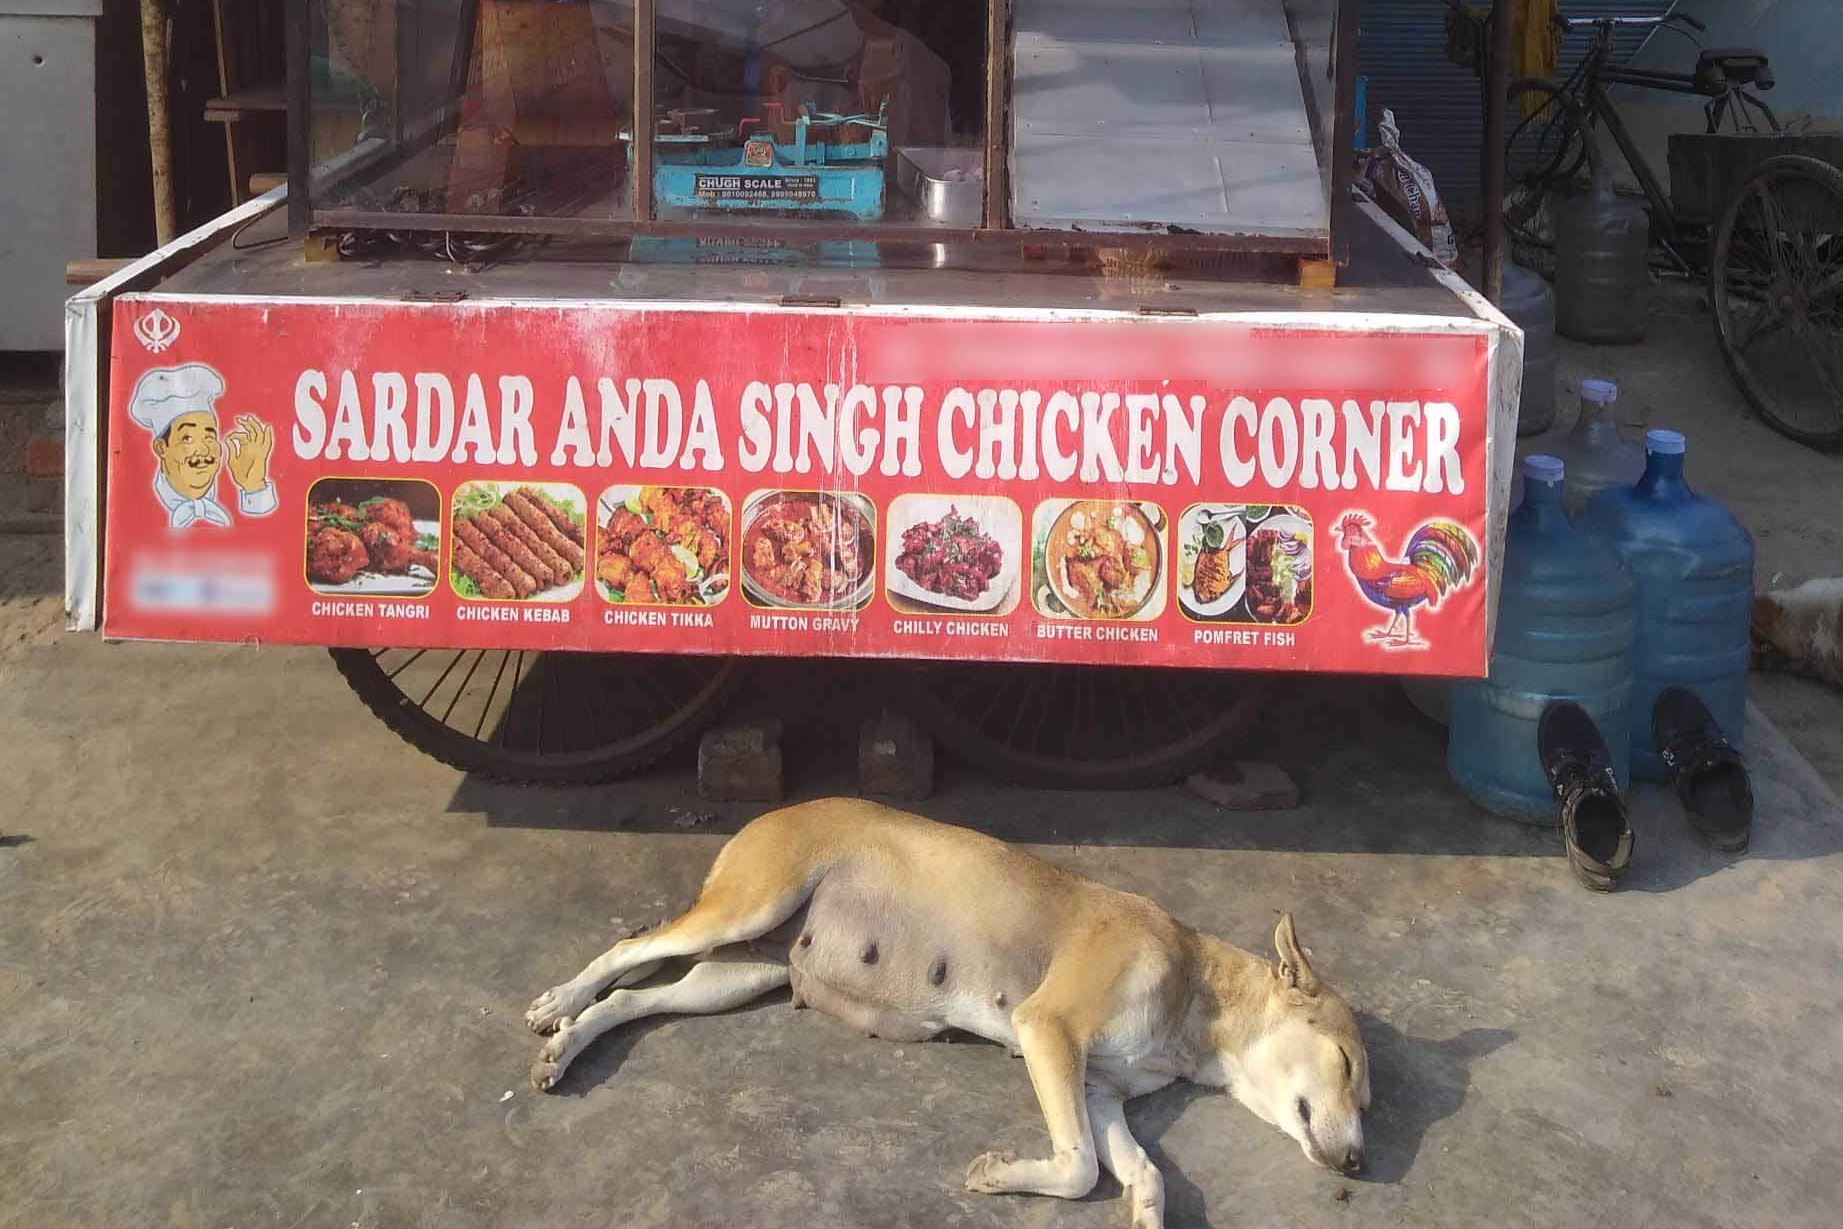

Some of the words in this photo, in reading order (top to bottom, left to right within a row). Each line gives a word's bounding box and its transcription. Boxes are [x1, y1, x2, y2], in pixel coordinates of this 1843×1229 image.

[698, 175, 741, 190] CHUGH
[744, 178, 782, 189] SCALE
[292, 369, 538, 467] SARDAR
[550, 375, 724, 470] ANDA
[737, 380, 924, 475] SINGH
[936, 385, 1206, 486] CHICKEN
[1219, 395, 1465, 496] CORNER
[311, 601, 374, 617] CHICKEN
[377, 603, 430, 619] TANGRI
[456, 605, 519, 621] CHICKEN
[522, 608, 571, 623] KEBAB
[604, 609, 667, 626] CHICKEN
[670, 612, 714, 628] TIKKA
[750, 614, 808, 631] MUTTON
[812, 617, 860, 632] GRAVY
[893, 620, 943, 635] CHILLY
[946, 622, 1009, 637] CHICKEN
[1036, 625, 1092, 640] BUTTER
[1095, 626, 1158, 642] CHICKEN
[1194, 629, 1259, 645] POMFRET
[1263, 631, 1296, 646] FISH
